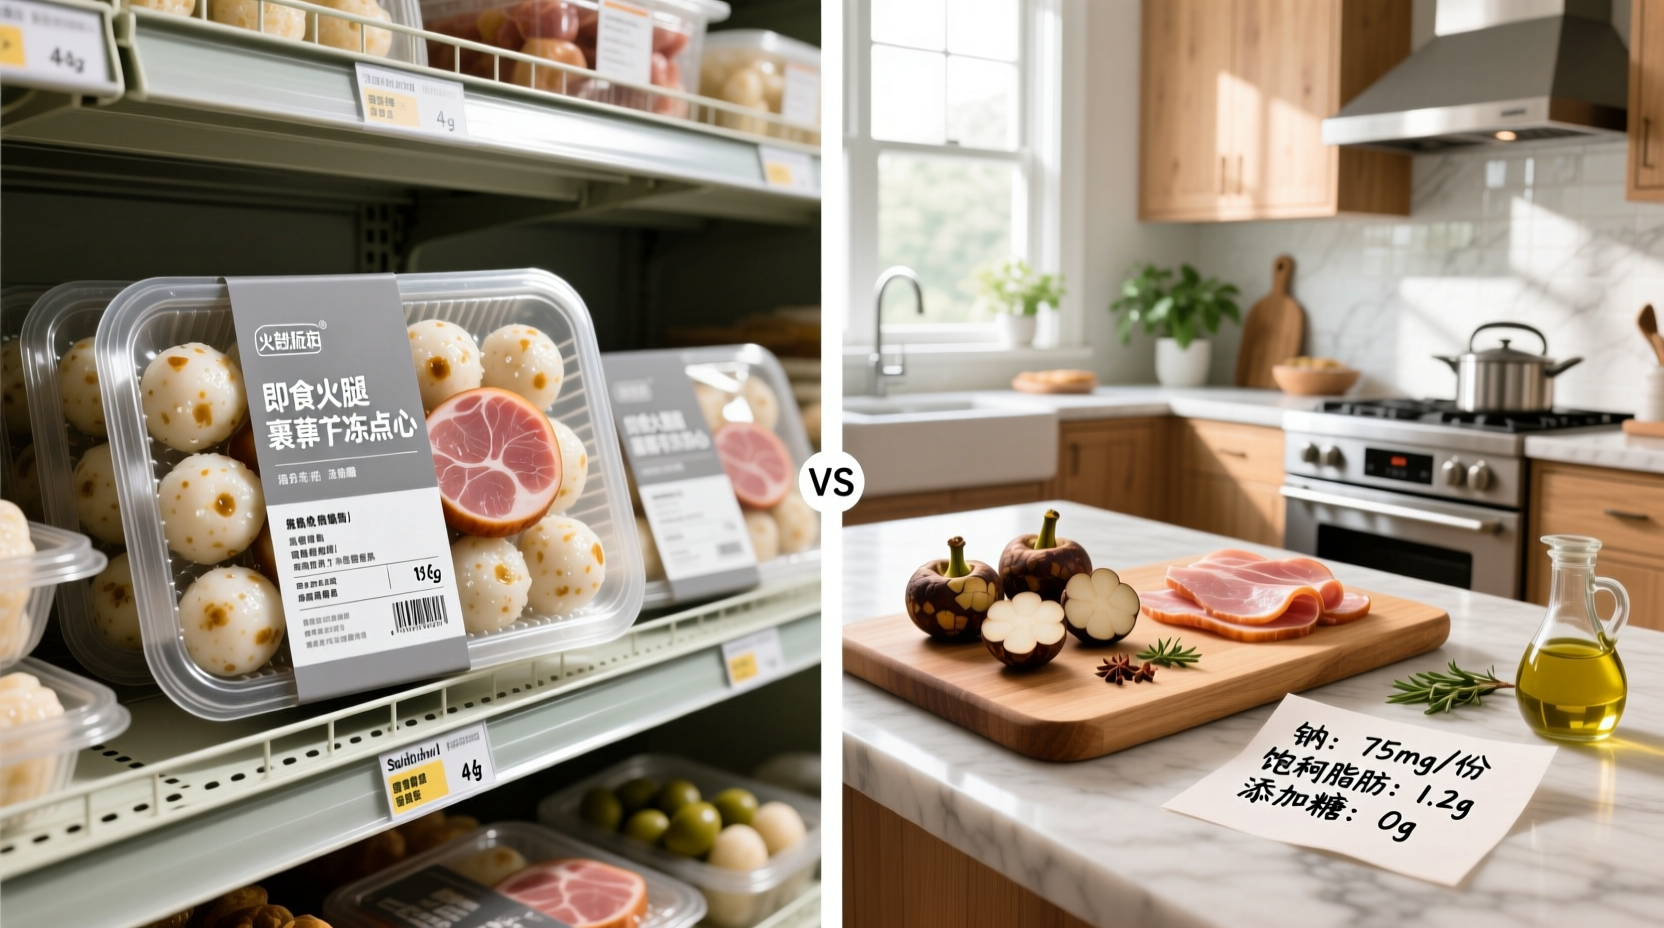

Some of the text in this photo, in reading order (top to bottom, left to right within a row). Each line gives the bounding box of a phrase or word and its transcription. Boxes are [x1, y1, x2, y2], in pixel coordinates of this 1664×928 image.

[436, 110, 455, 132] 4g
[262, 375, 370, 413] 即食火腿
[1293, 721, 1492, 781] 钠： 75mg/份
[1237, 776, 1417, 842] 添加糖： 0g
[1416, 784, 1475, 820] 1.2g
